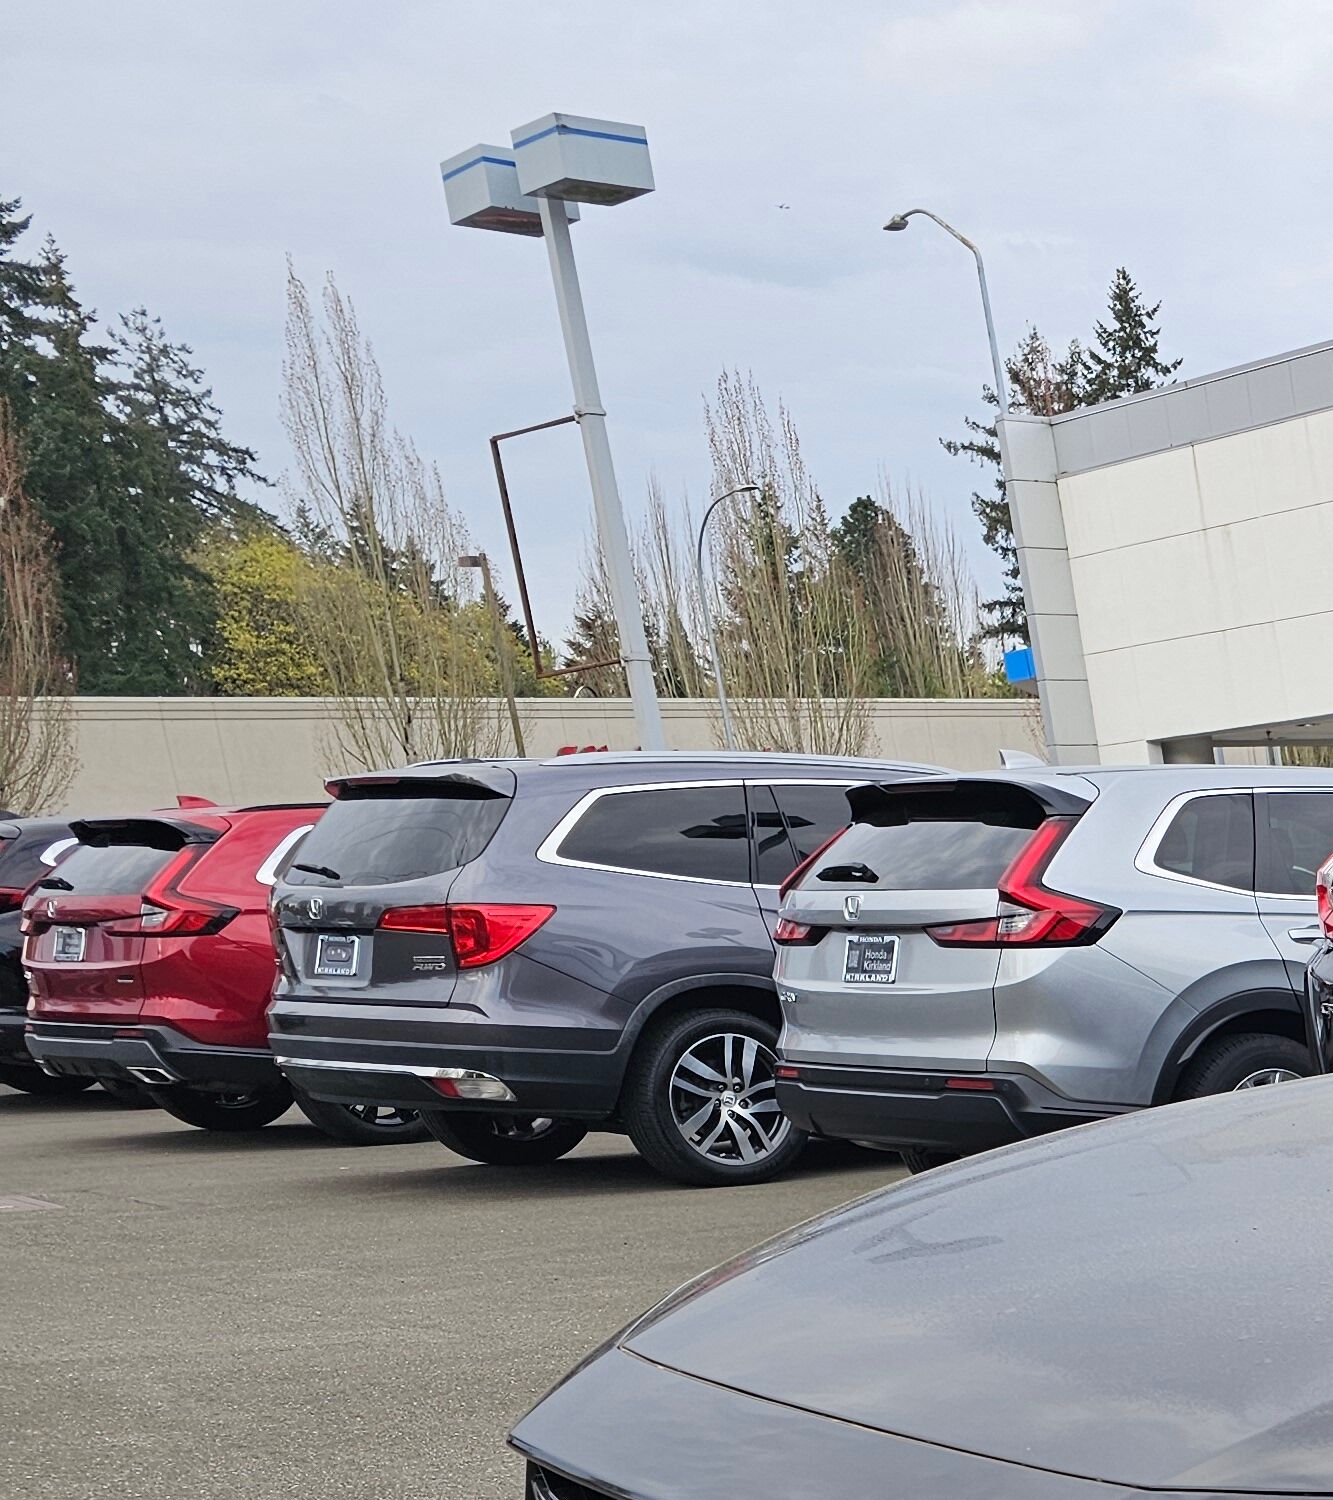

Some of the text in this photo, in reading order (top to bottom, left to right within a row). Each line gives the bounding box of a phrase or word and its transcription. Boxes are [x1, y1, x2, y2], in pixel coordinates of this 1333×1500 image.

[864, 949, 887, 960] Honda
[863, 960, 892, 971] Kirkland
[846, 973, 890, 982] KIRKLAND
